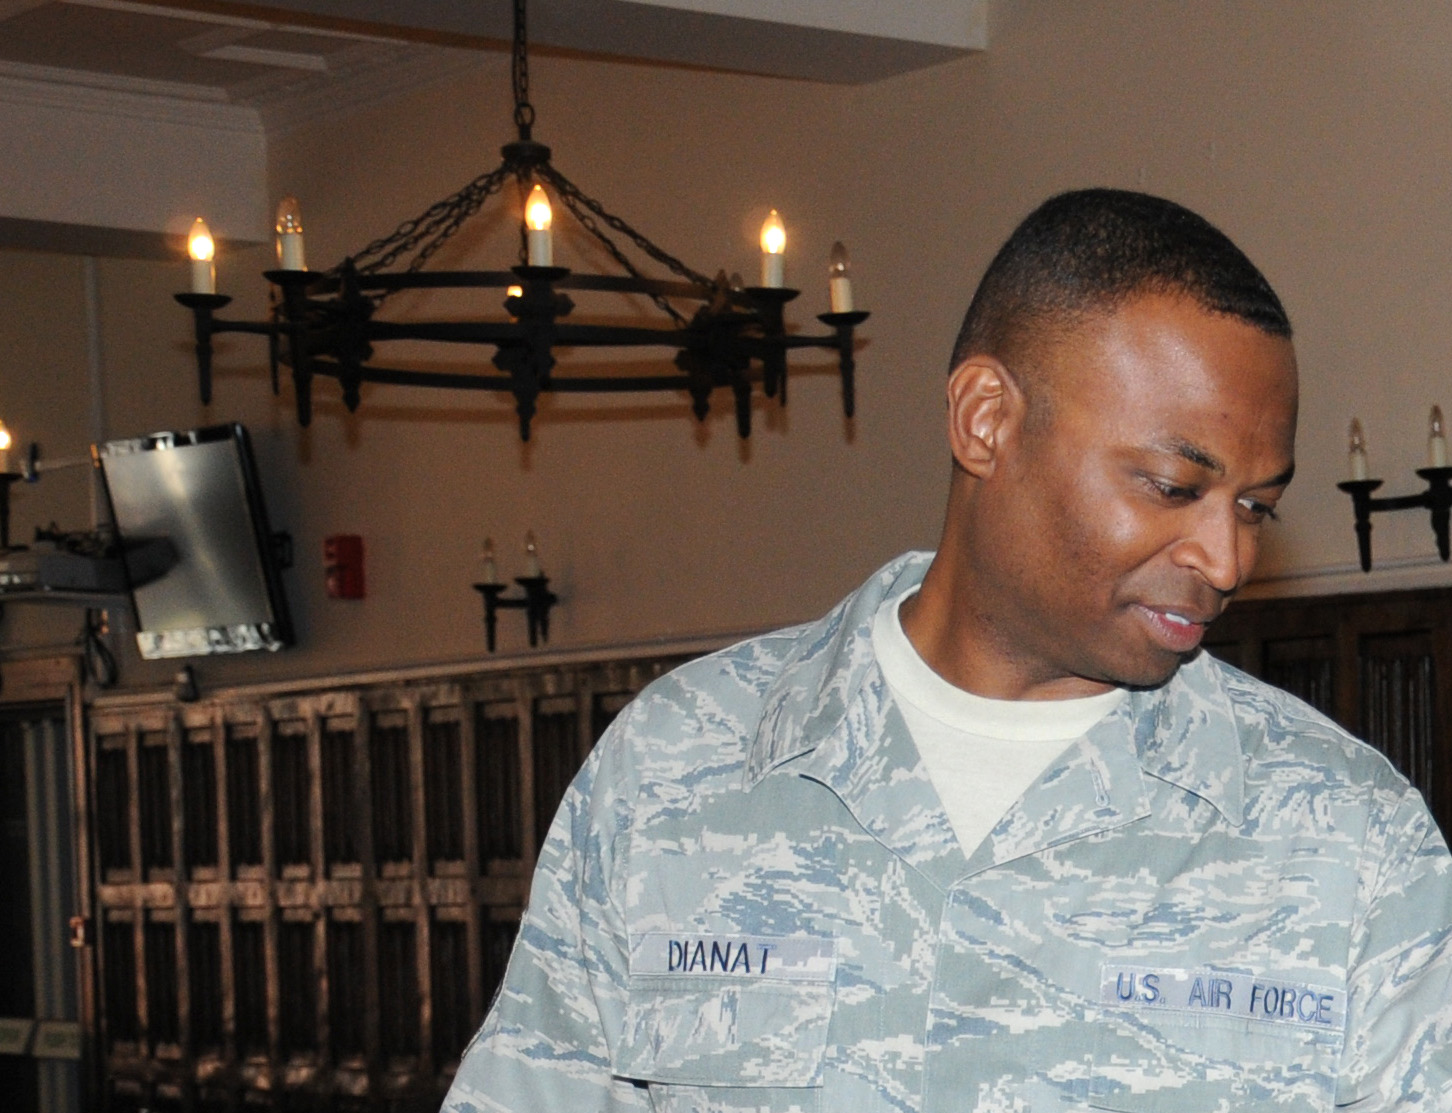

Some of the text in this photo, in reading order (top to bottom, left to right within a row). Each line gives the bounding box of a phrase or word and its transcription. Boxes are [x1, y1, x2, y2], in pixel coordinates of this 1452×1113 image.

[668, 939, 778, 974] DIANAT
[1116, 972, 1334, 1024] U.S. AIR FORCE
